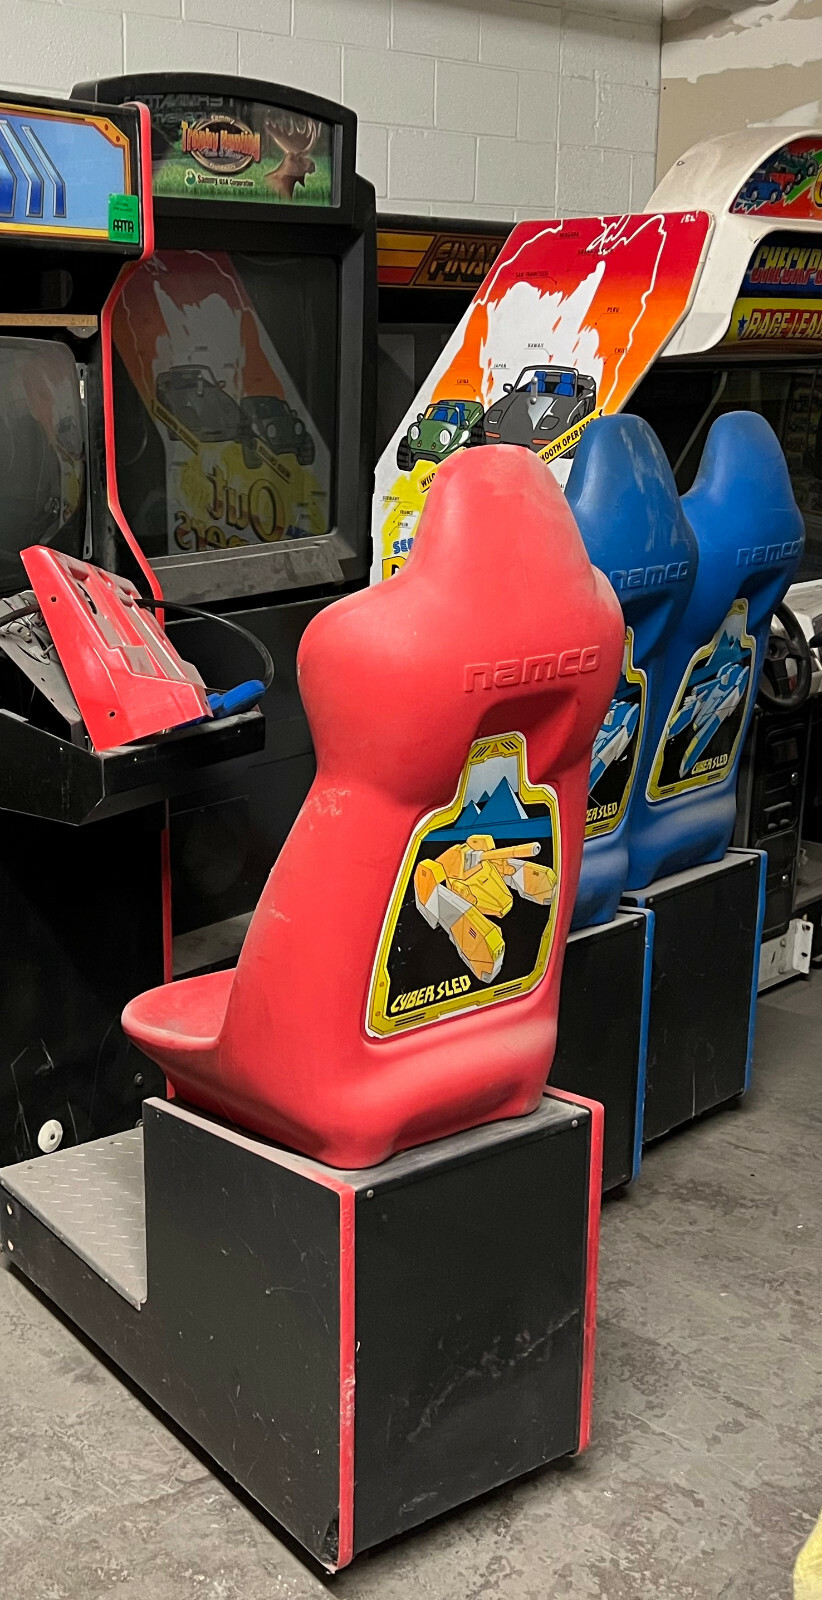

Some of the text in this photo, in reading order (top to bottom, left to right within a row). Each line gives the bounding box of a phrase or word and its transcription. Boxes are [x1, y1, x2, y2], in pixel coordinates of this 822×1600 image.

[197, 175, 218, 185] Sammy
[742, 311, 791, 338] RACE
[540, 418, 594, 461] MOOTH OPERAT
[736, 539, 803, 567] namco
[609, 560, 690, 590] namco
[463, 645, 602, 693] namco
[712, 753, 728, 769] SLED
[597, 801, 618, 820] SLED
[390, 974, 471, 1014] CYBER SLED
